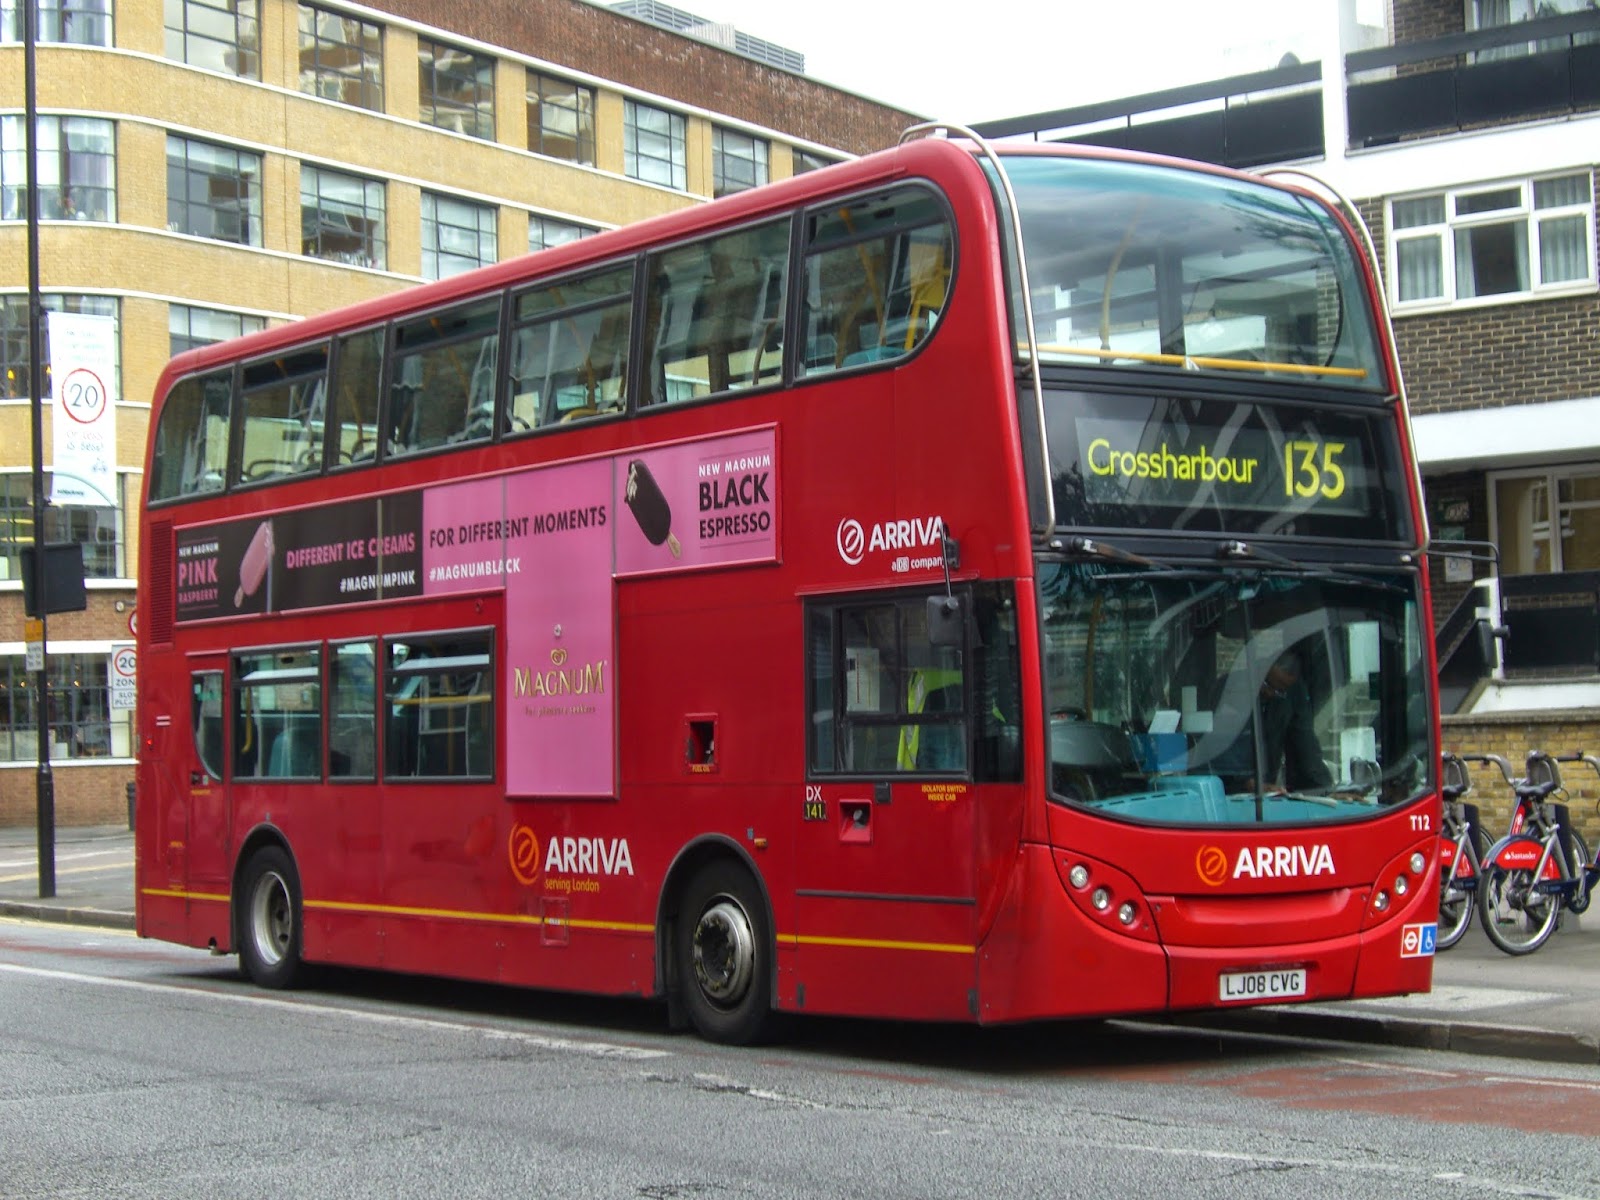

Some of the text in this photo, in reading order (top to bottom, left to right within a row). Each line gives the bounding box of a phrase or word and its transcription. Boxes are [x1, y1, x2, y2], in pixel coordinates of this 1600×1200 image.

[69, 383, 98, 408] 20
[698, 454, 771, 478] NEW MAGNUM
[1087, 437, 1346, 499] Crossharbour 135
[699, 471, 771, 512] BLACK
[429, 504, 607, 549] FOR DIFFERENT MOMENTS
[699, 510, 771, 540] ESPRESSO
[868, 515, 947, 552] ARRIVA
[192, 542, 219, 556] MAGNUM
[286, 542, 344, 569] DIFFERENT
[346, 538, 366, 561] ICE
[178, 557, 219, 588] PINK
[340, 570, 416, 593] #MAGNUMPINK
[428, 557, 521, 582] #MAGNUMBLACK
[119, 656, 137, 669] 20
[115, 678, 136, 687] ZON
[513, 660, 605, 698] MAGNUM
[119, 691, 137, 699] SLO
[805, 785, 823, 802] DX
[806, 803, 823, 819] 141
[1409, 814, 1431, 832] T12
[544, 835, 635, 876] ARRIVA
[1232, 844, 1336, 880] ARRIVA
[544, 877, 600, 894] serving London
[1226, 972, 1300, 996] LJ08 CVG
